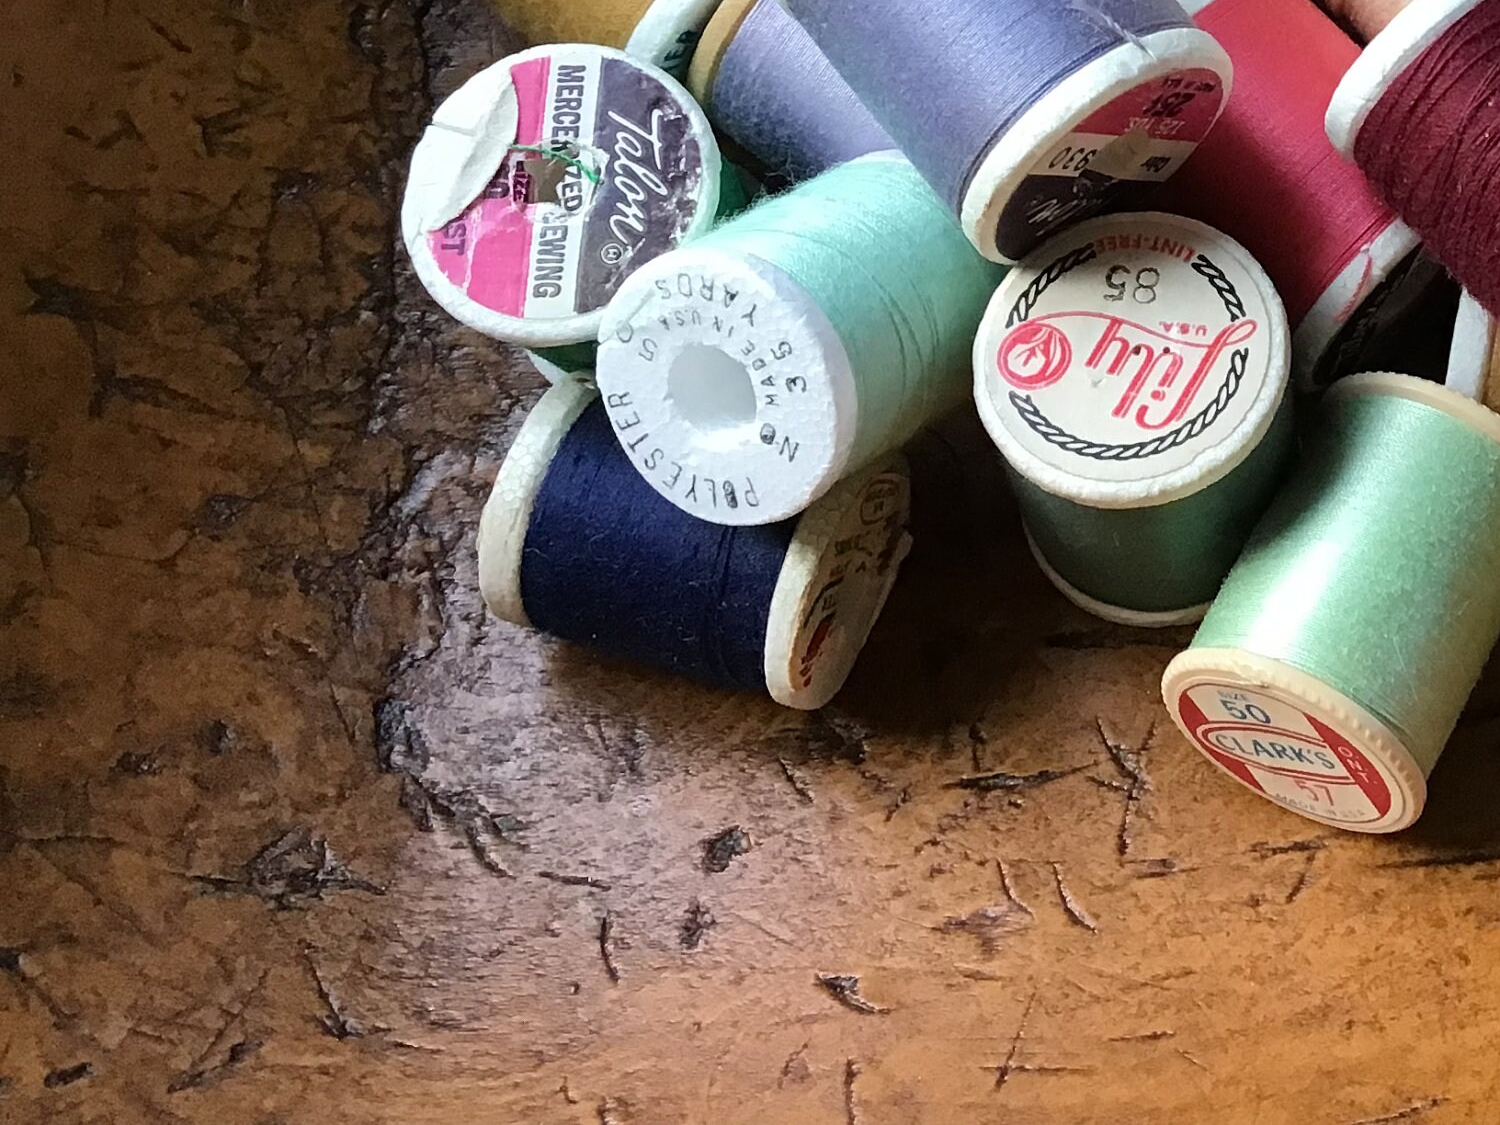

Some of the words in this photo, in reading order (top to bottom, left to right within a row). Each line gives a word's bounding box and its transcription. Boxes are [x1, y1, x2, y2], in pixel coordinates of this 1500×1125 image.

[551, 64, 587, 212] MERCERZED
[655, 272, 757, 327] YARDS
[1103, 264, 1160, 304] 85
[1219, 698, 1272, 725] 50
[1215, 734, 1335, 770] CLARK'S
[1294, 778, 1334, 807] 57
